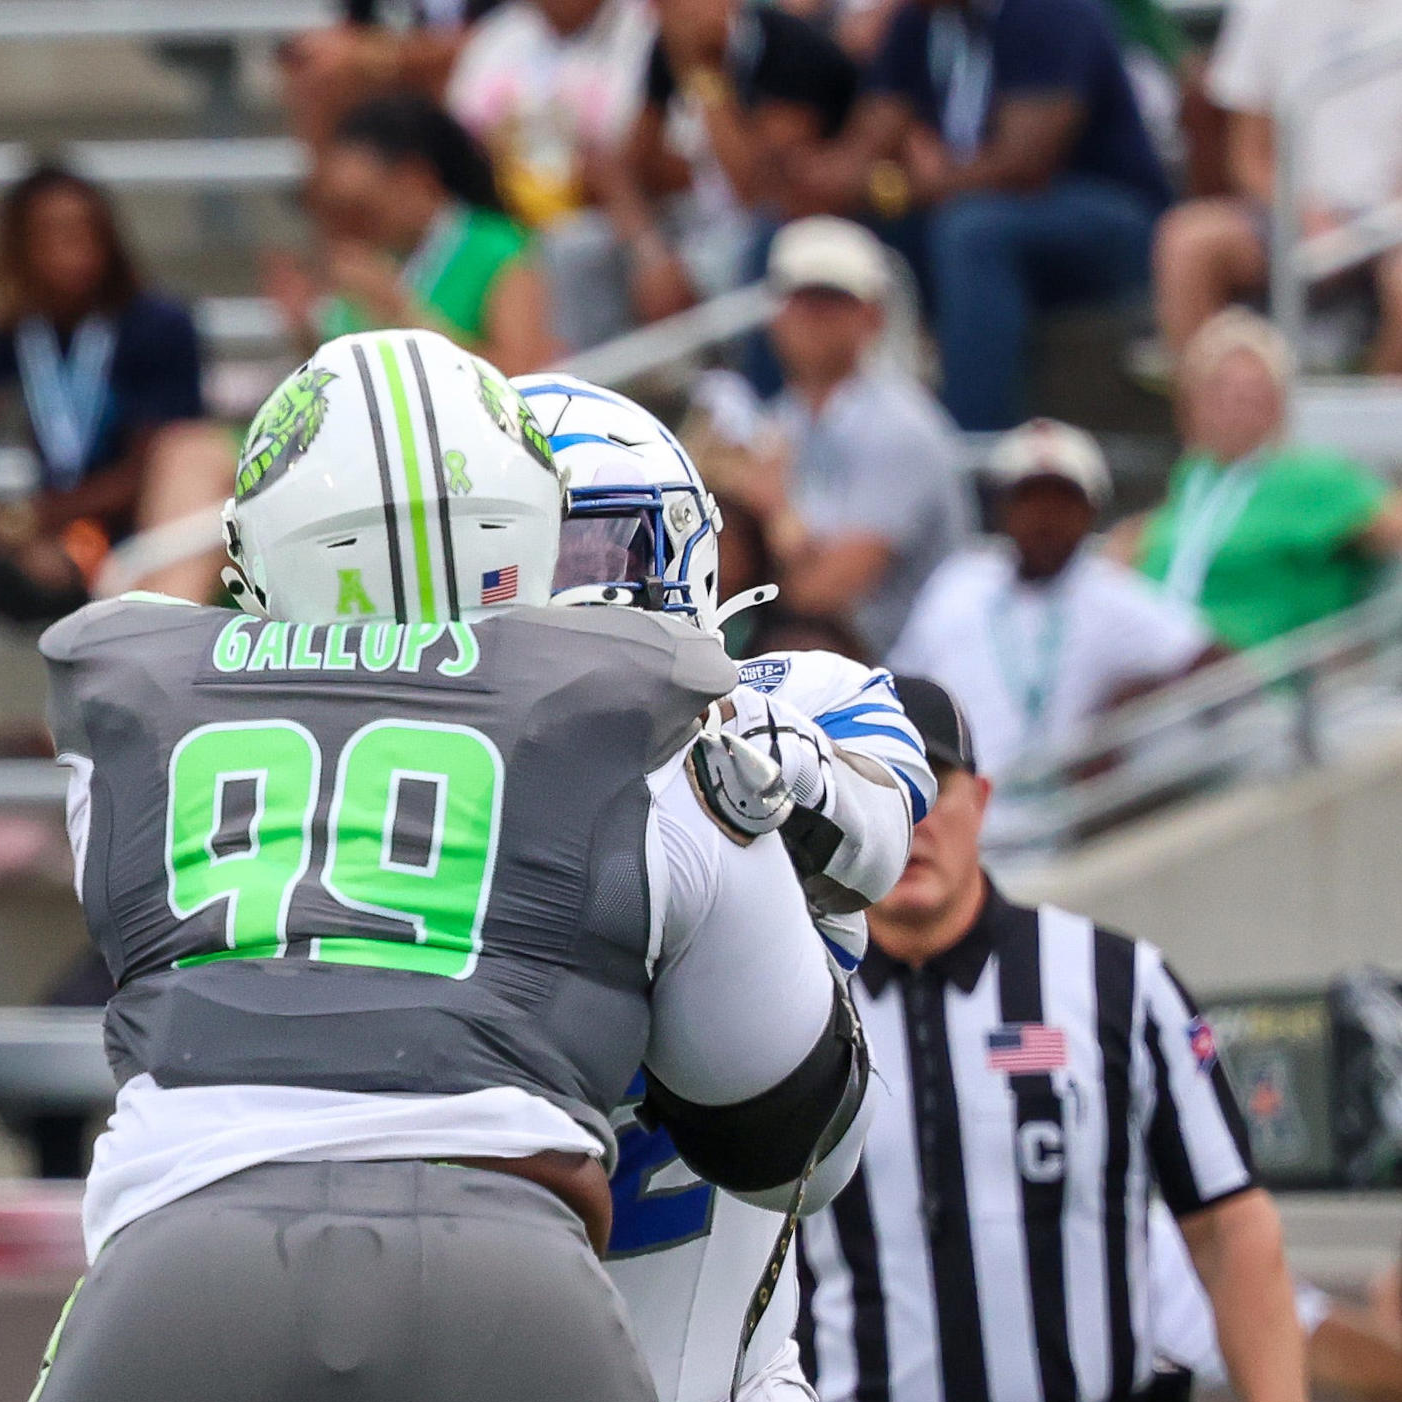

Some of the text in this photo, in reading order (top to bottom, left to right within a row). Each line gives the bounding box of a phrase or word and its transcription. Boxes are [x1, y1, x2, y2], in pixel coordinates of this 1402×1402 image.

[212, 614, 480, 678] GALLUPS
[163, 717, 505, 981] 99
[1017, 1120, 1065, 1183] C
